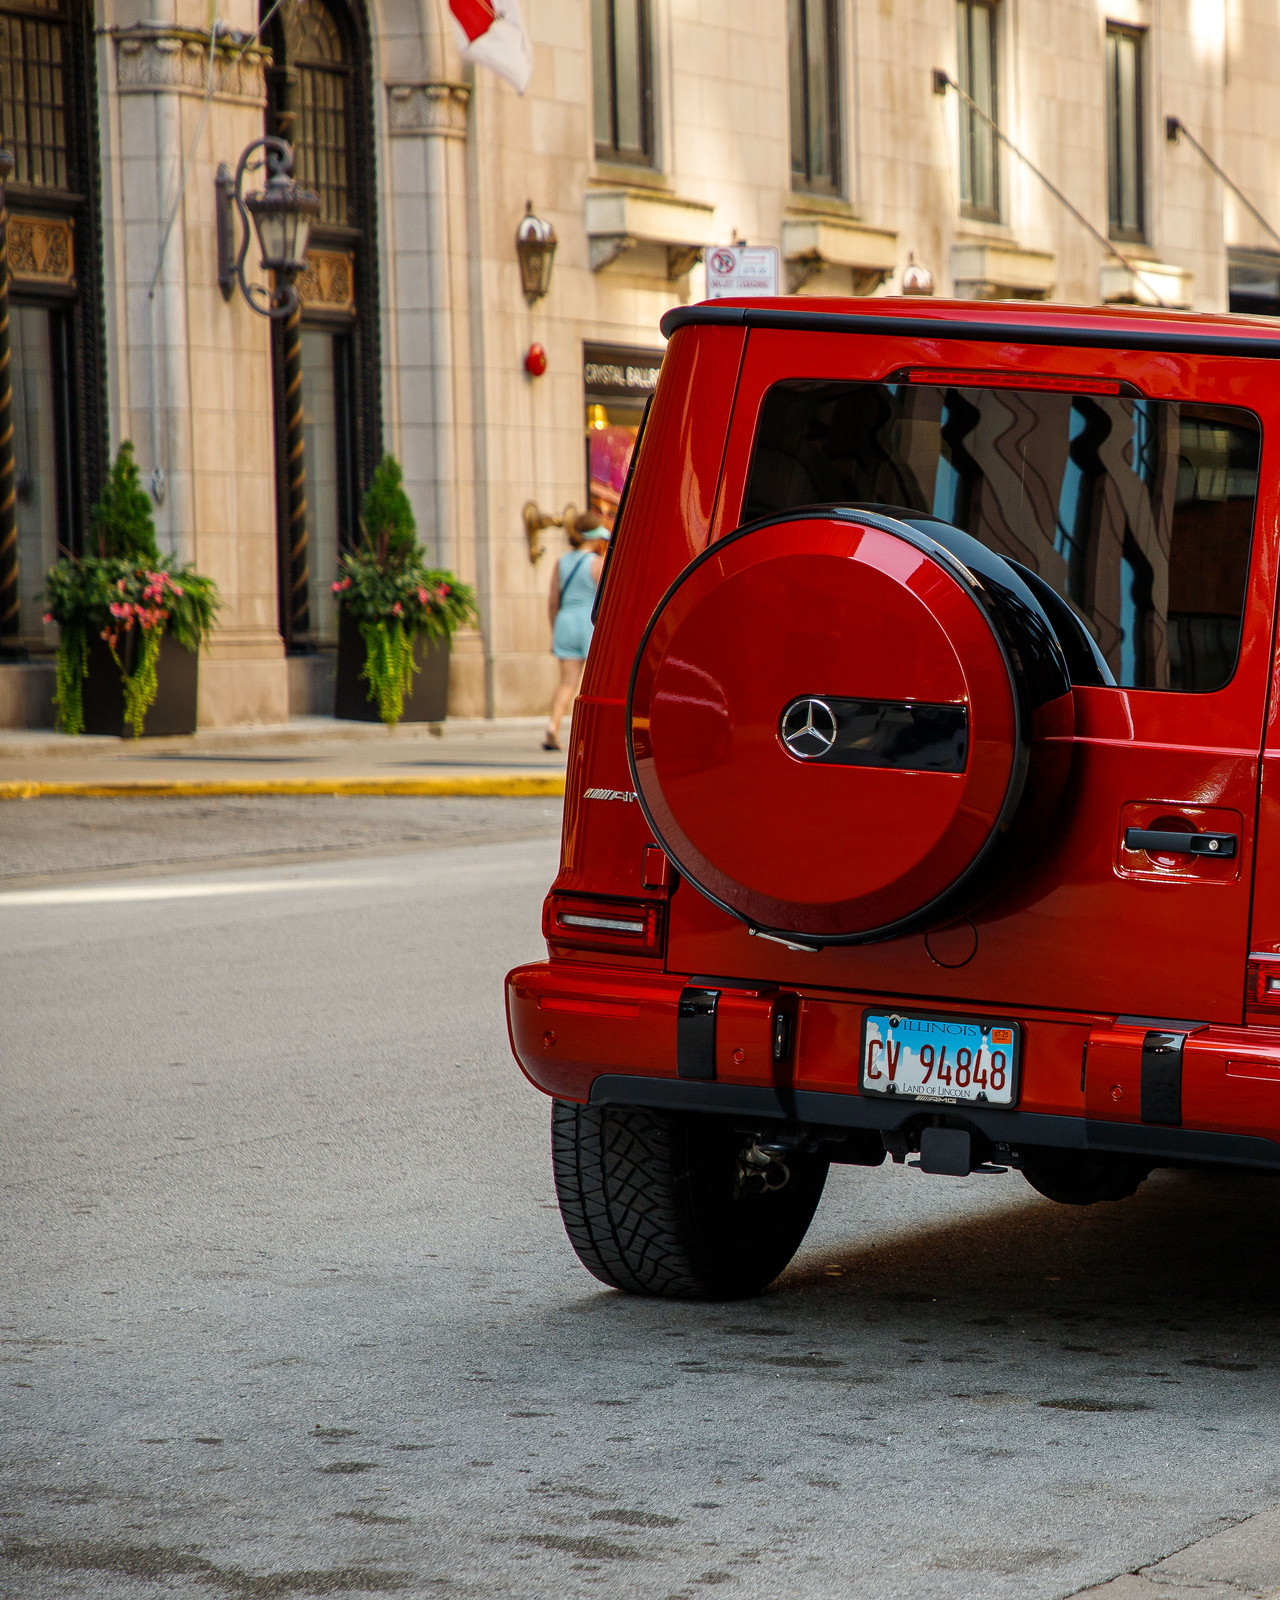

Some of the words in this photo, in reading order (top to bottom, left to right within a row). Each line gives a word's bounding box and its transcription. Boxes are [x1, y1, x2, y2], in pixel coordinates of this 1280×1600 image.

[584, 362, 626, 386] CRYSTAL
[903, 1020, 977, 1037] ILLINOIS
[867, 1039, 901, 1081] CV
[920, 1044, 1006, 1090] 94848
[903, 1083, 925, 1094] LAND
[928, 1086, 937, 1095] OF
[938, 1086, 971, 1098] LINCOLN
